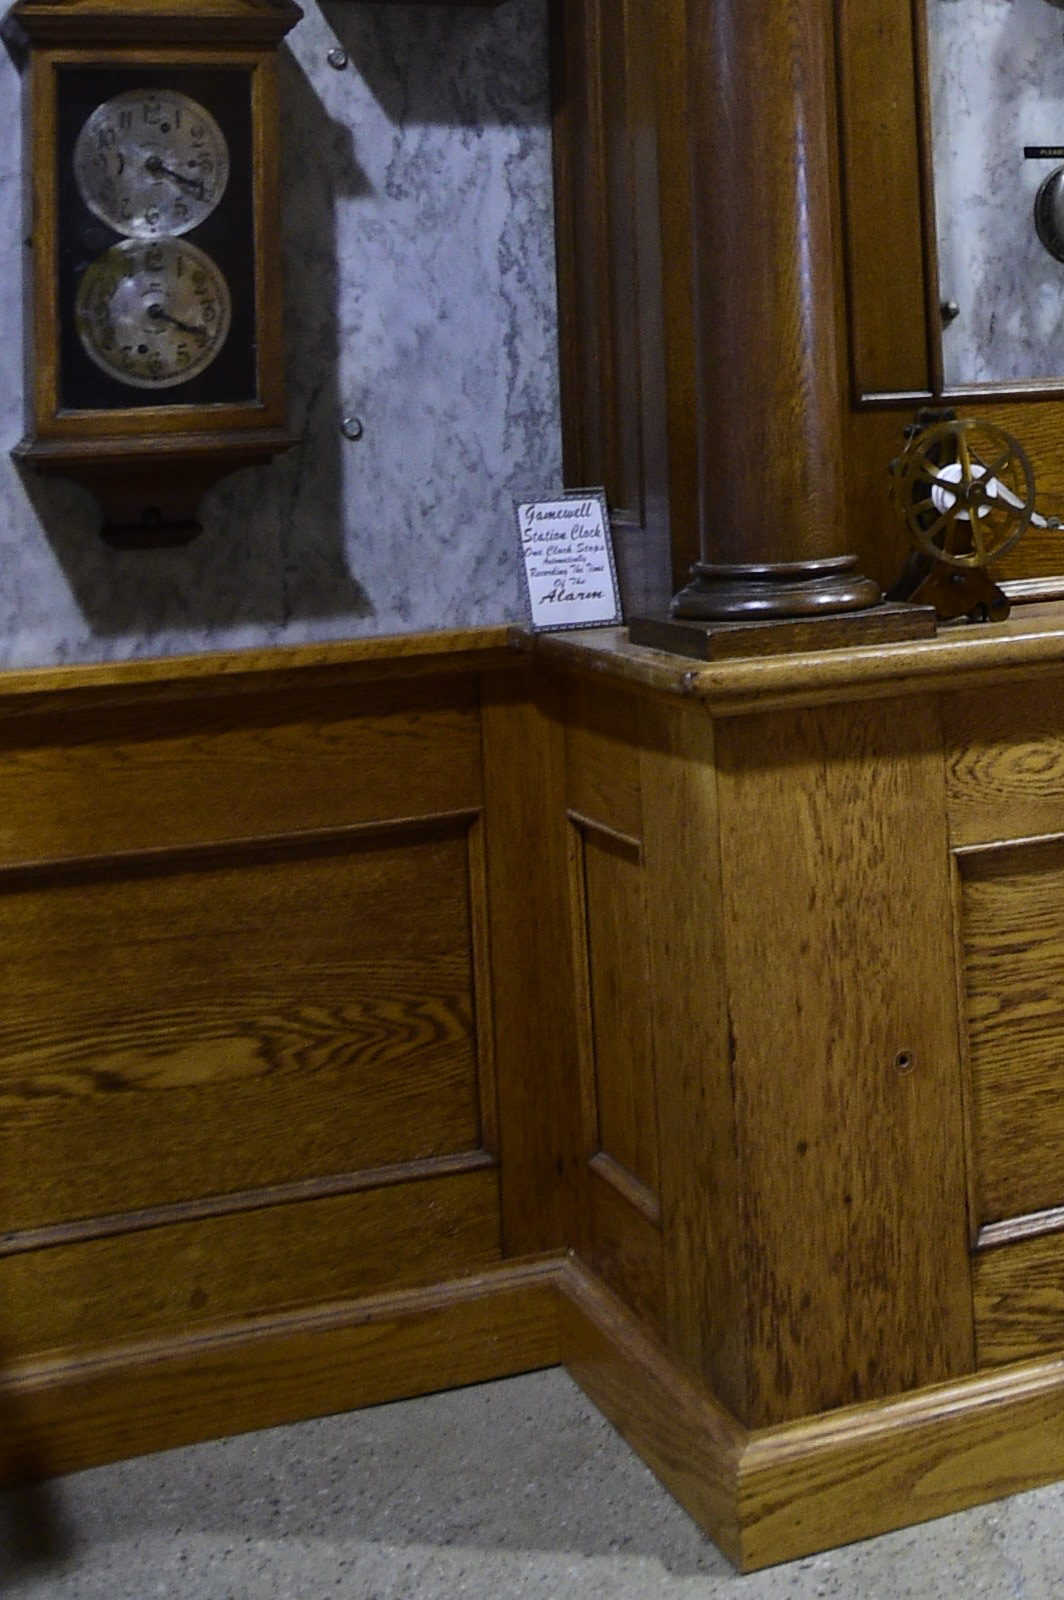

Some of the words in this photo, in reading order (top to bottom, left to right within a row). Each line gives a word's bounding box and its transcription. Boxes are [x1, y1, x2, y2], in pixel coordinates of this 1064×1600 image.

[524, 502, 592, 526] Gamewell
[523, 528, 567, 543] Station
[570, 524, 602, 540] Clock
[546, 545, 573, 556] Clock
[576, 543, 605, 553] Stops
[538, 588, 605, 605] Alarm
